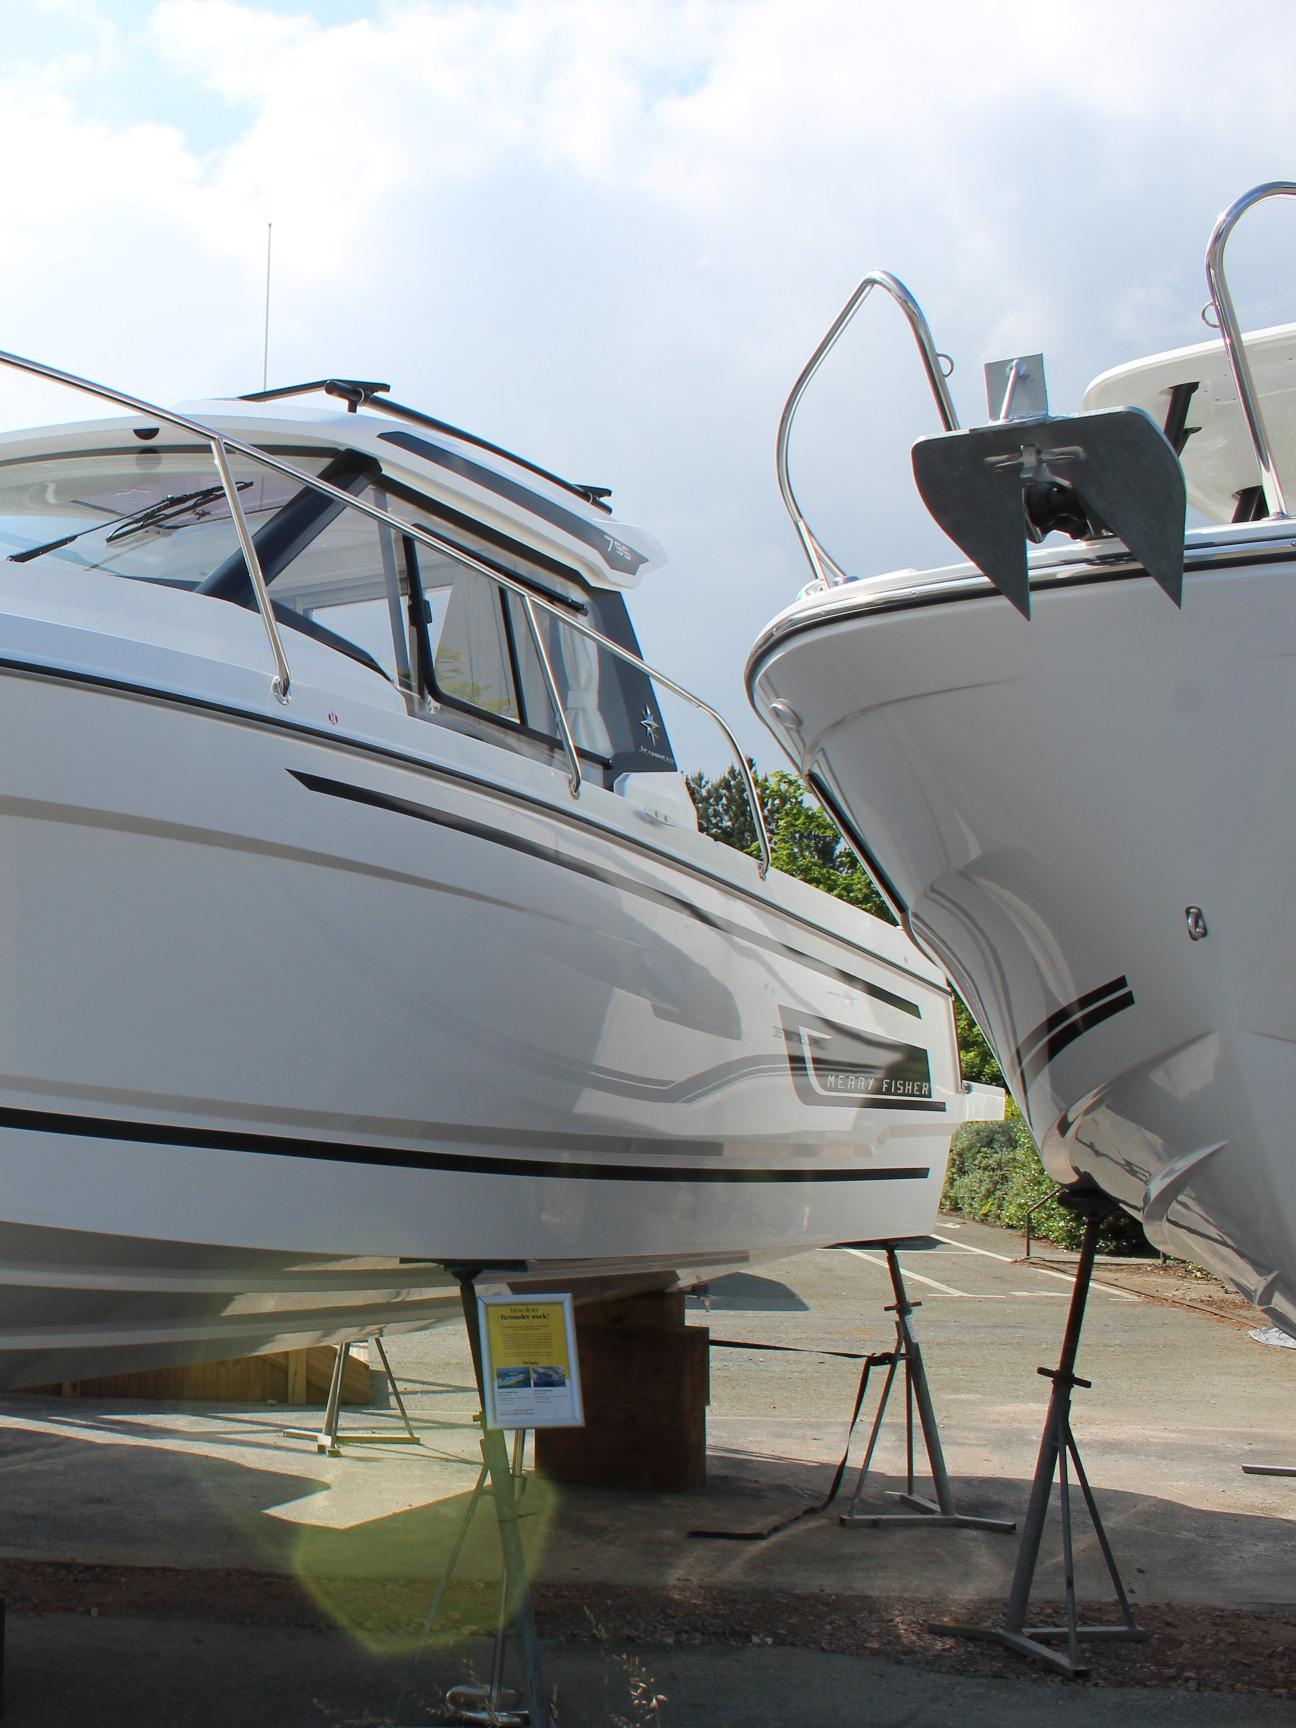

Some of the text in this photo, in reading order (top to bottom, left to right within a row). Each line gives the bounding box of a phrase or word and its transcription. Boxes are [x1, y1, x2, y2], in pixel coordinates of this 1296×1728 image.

[604, 534, 632, 561] 795
[827, 1075, 929, 1096] MERRY FISHER
